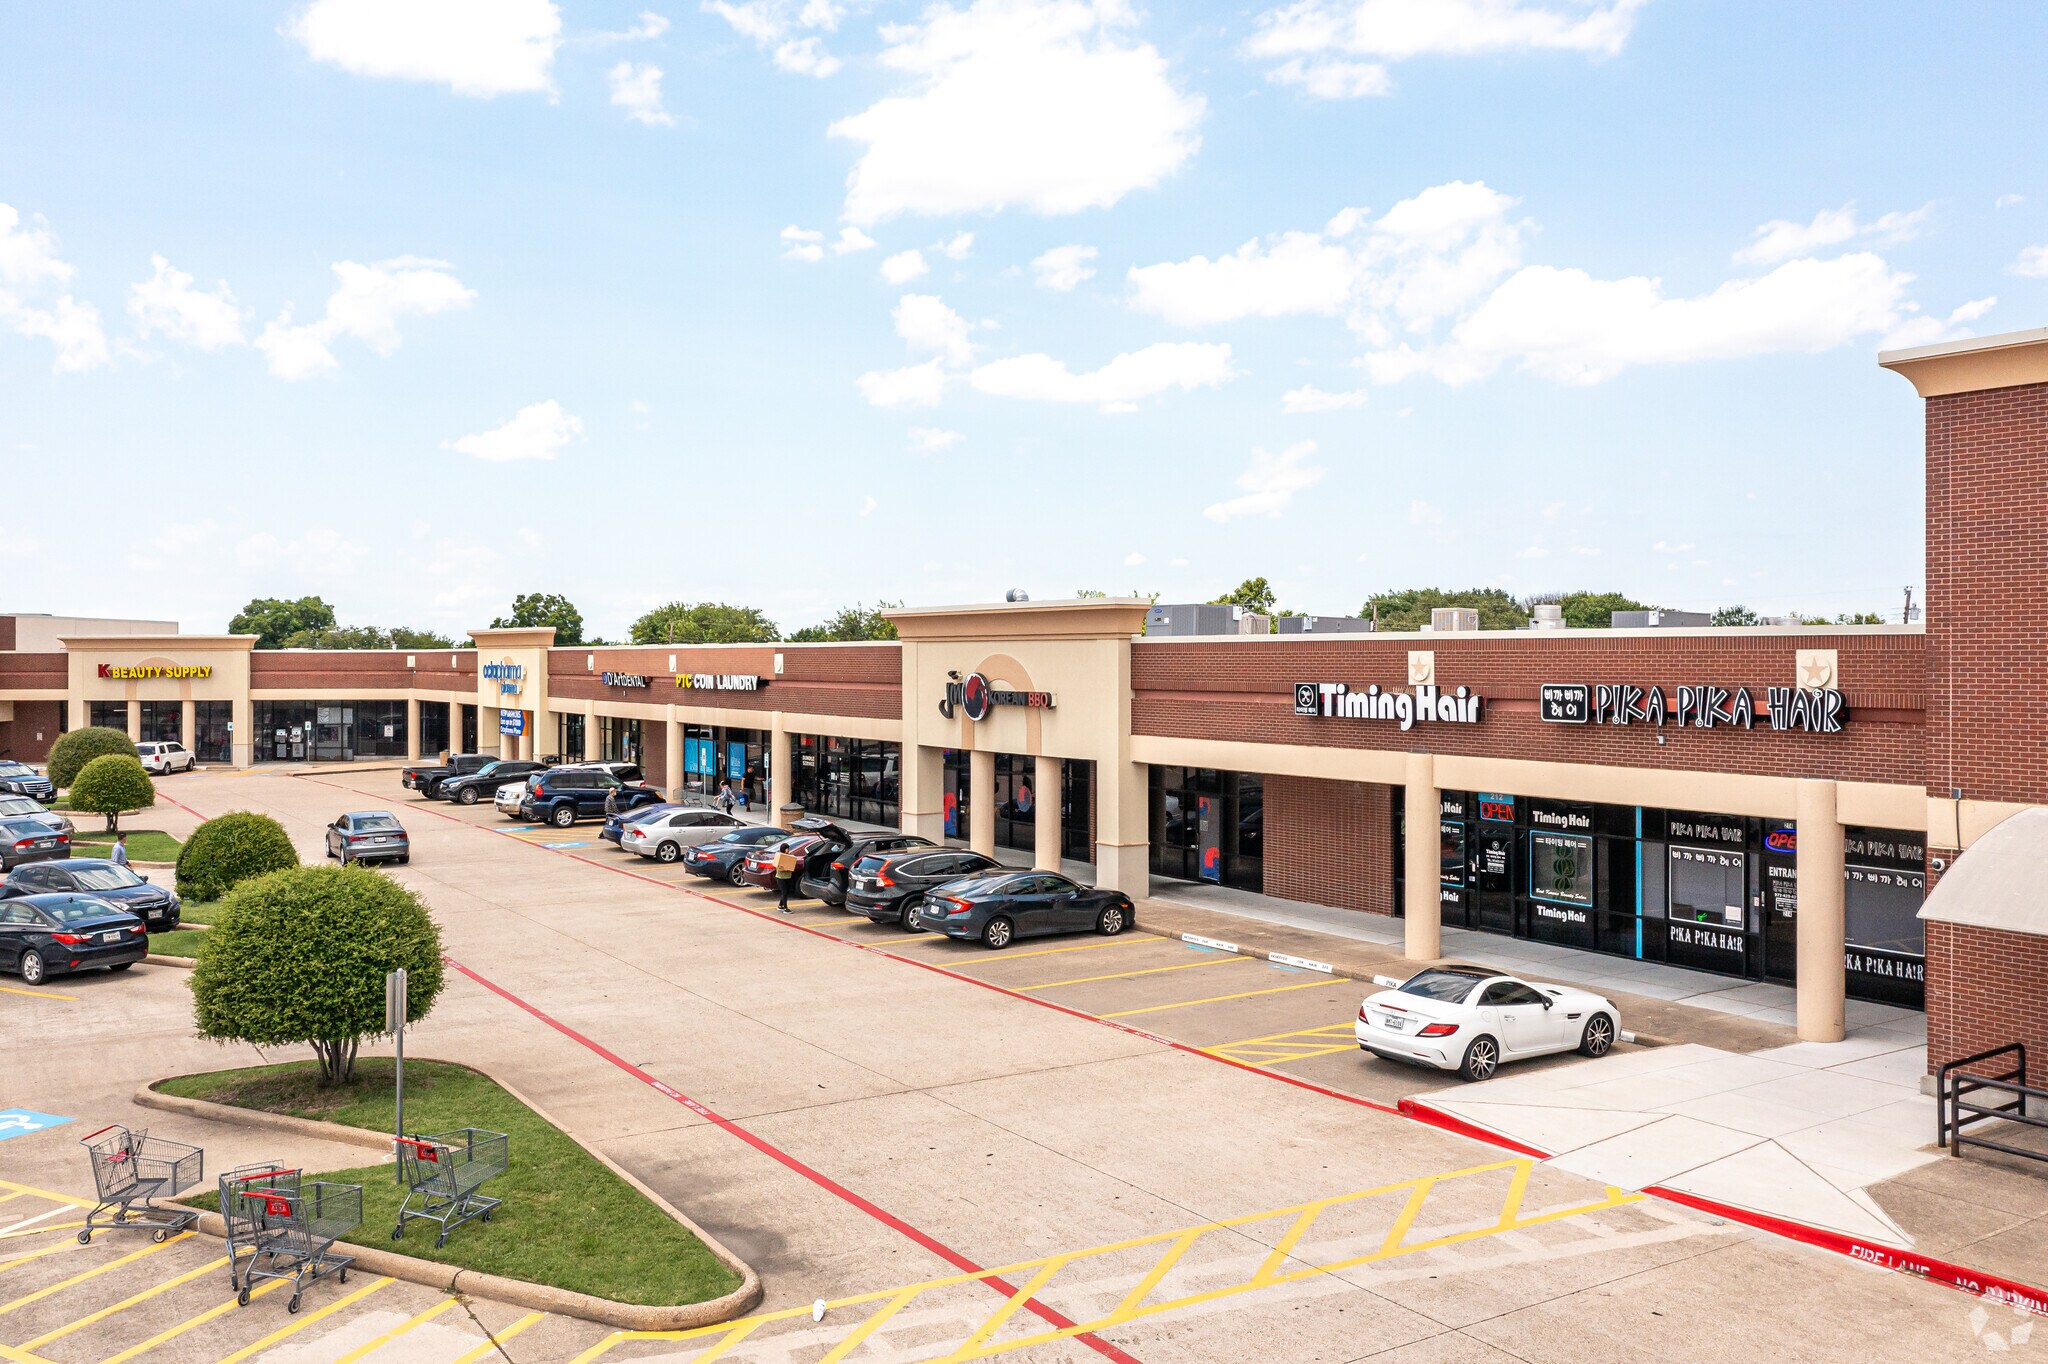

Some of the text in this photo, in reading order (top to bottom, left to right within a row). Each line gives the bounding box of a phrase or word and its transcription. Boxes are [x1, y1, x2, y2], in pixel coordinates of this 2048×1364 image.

[98, 664, 211, 679] K BEAUTY SUPPLY
[675, 673, 758, 691] PTC COIN LAUNDRY
[988, 692, 1025, 705] KOREAN
[1028, 692, 1048, 709] BBQ
[1319, 683, 1479, 731] Timing Hair
[1444, 802, 1462, 814] Hair
[1481, 802, 1514, 820] OPEN
[1533, 810, 1590, 829] Timing Hair
[1768, 832, 1797, 849] OPE
[1769, 866, 1797, 879] ENTRAN
[1443, 890, 1459, 902] Hair
[1536, 905, 1586, 923] Timing Hair
[1956, 1276, 1981, 1295] NO
[1985, 1285, 2048, 1316] PARKIN
